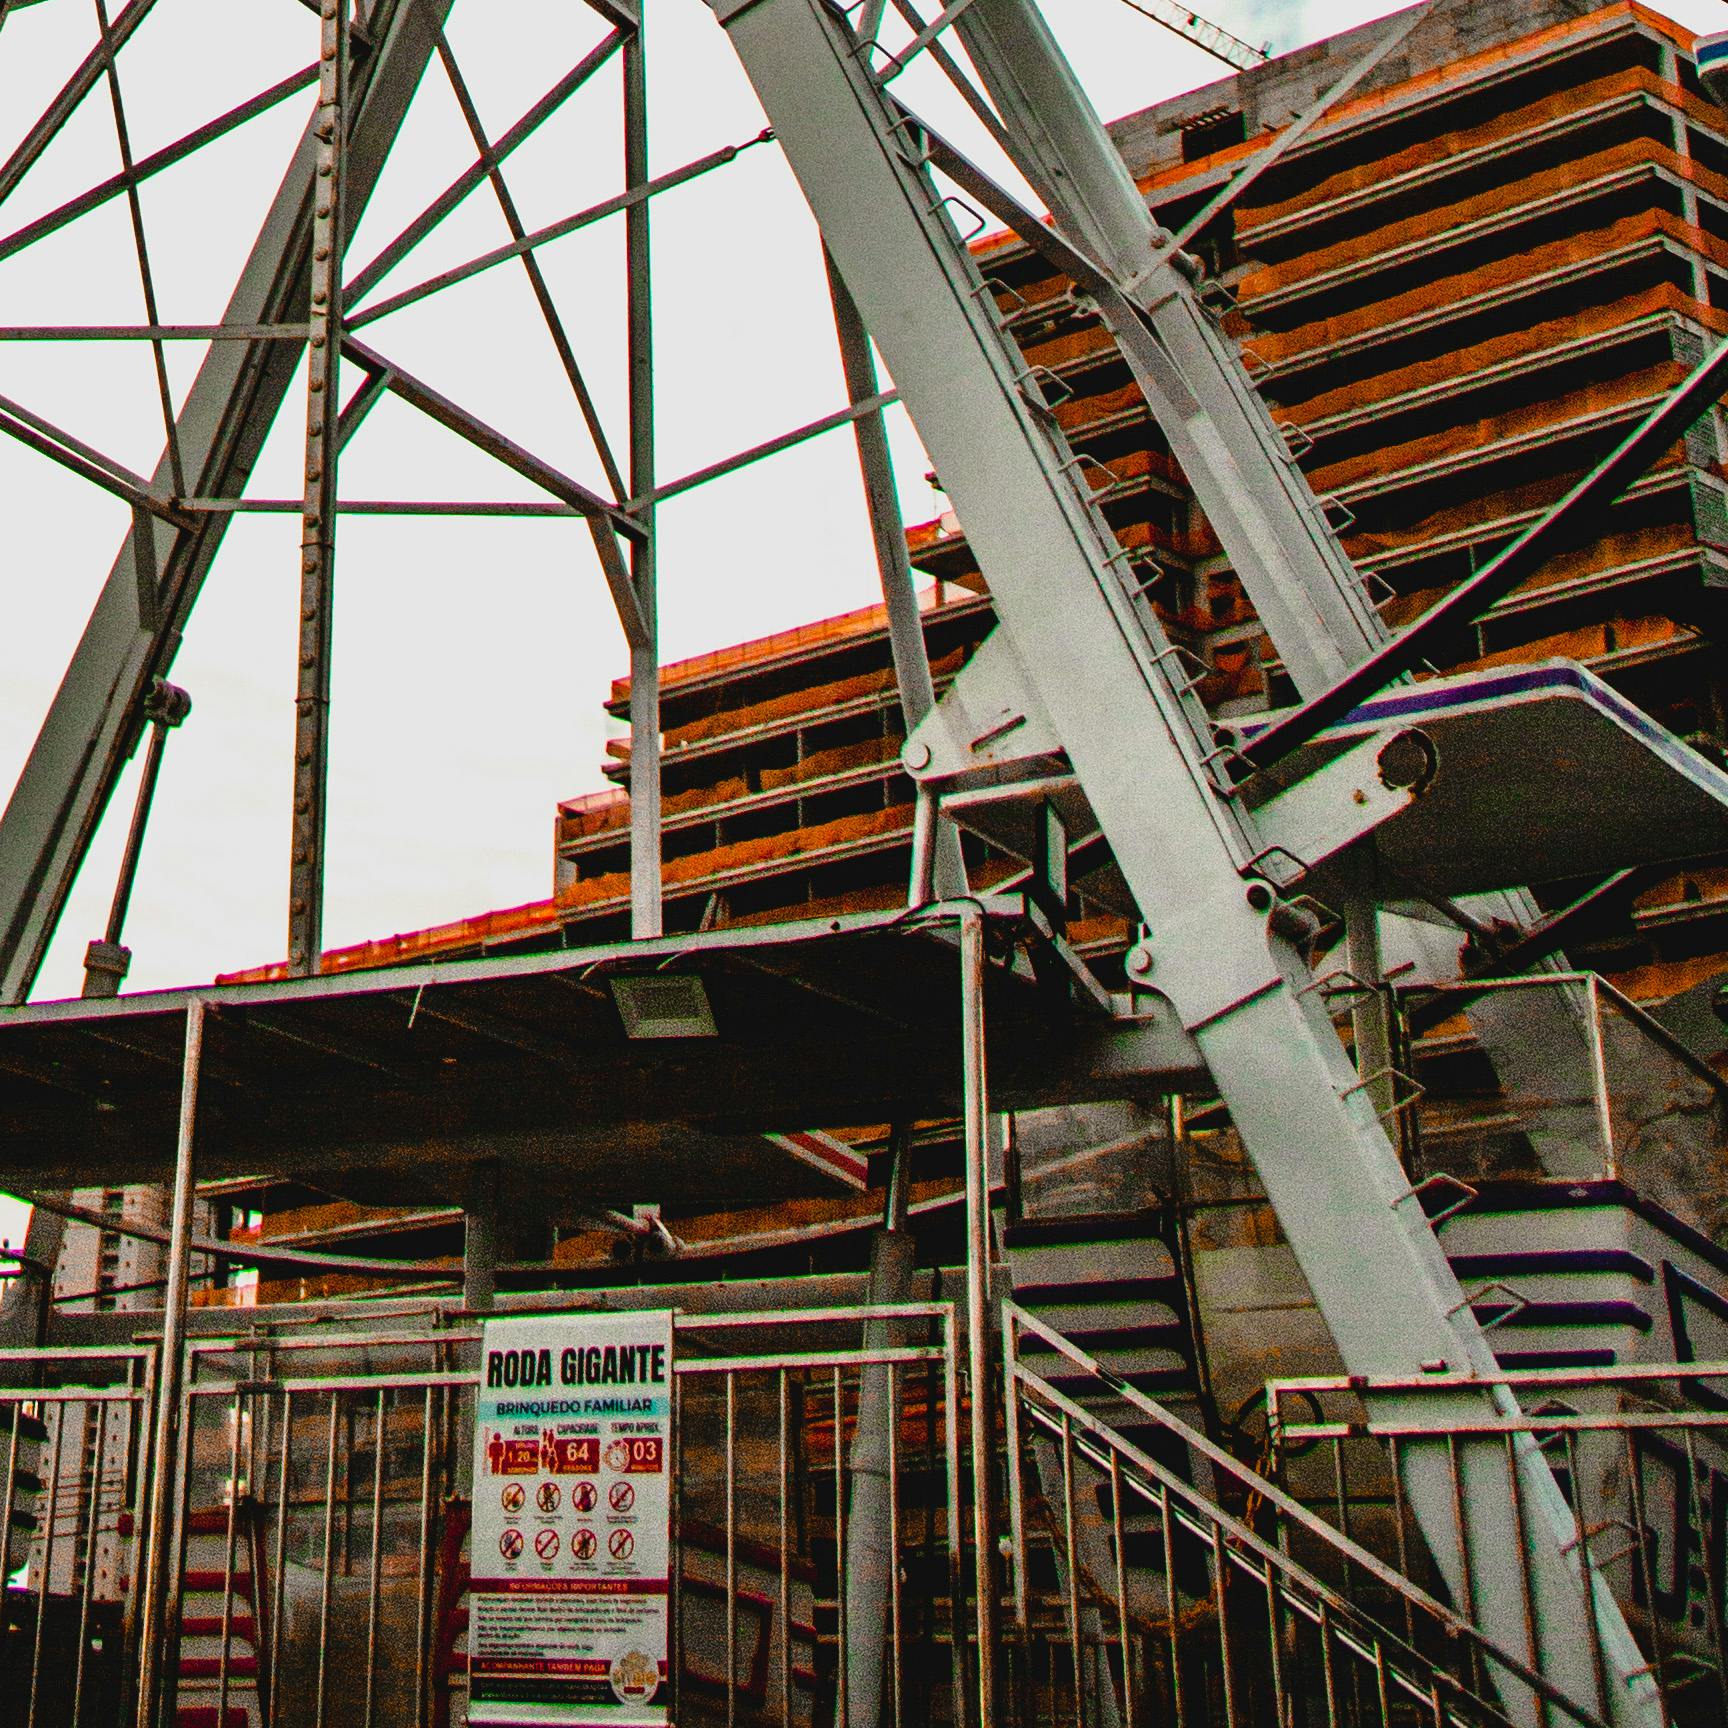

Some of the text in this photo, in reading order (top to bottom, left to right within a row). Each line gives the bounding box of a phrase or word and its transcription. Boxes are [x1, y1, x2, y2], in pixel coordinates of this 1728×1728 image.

[487, 1344, 665, 1388] RODA GIGANTE
[496, 1397, 653, 1416] BRINQUEDO FAMILIAR
[567, 1442, 589, 1461] 64
[633, 1441, 656, 1460] 03
